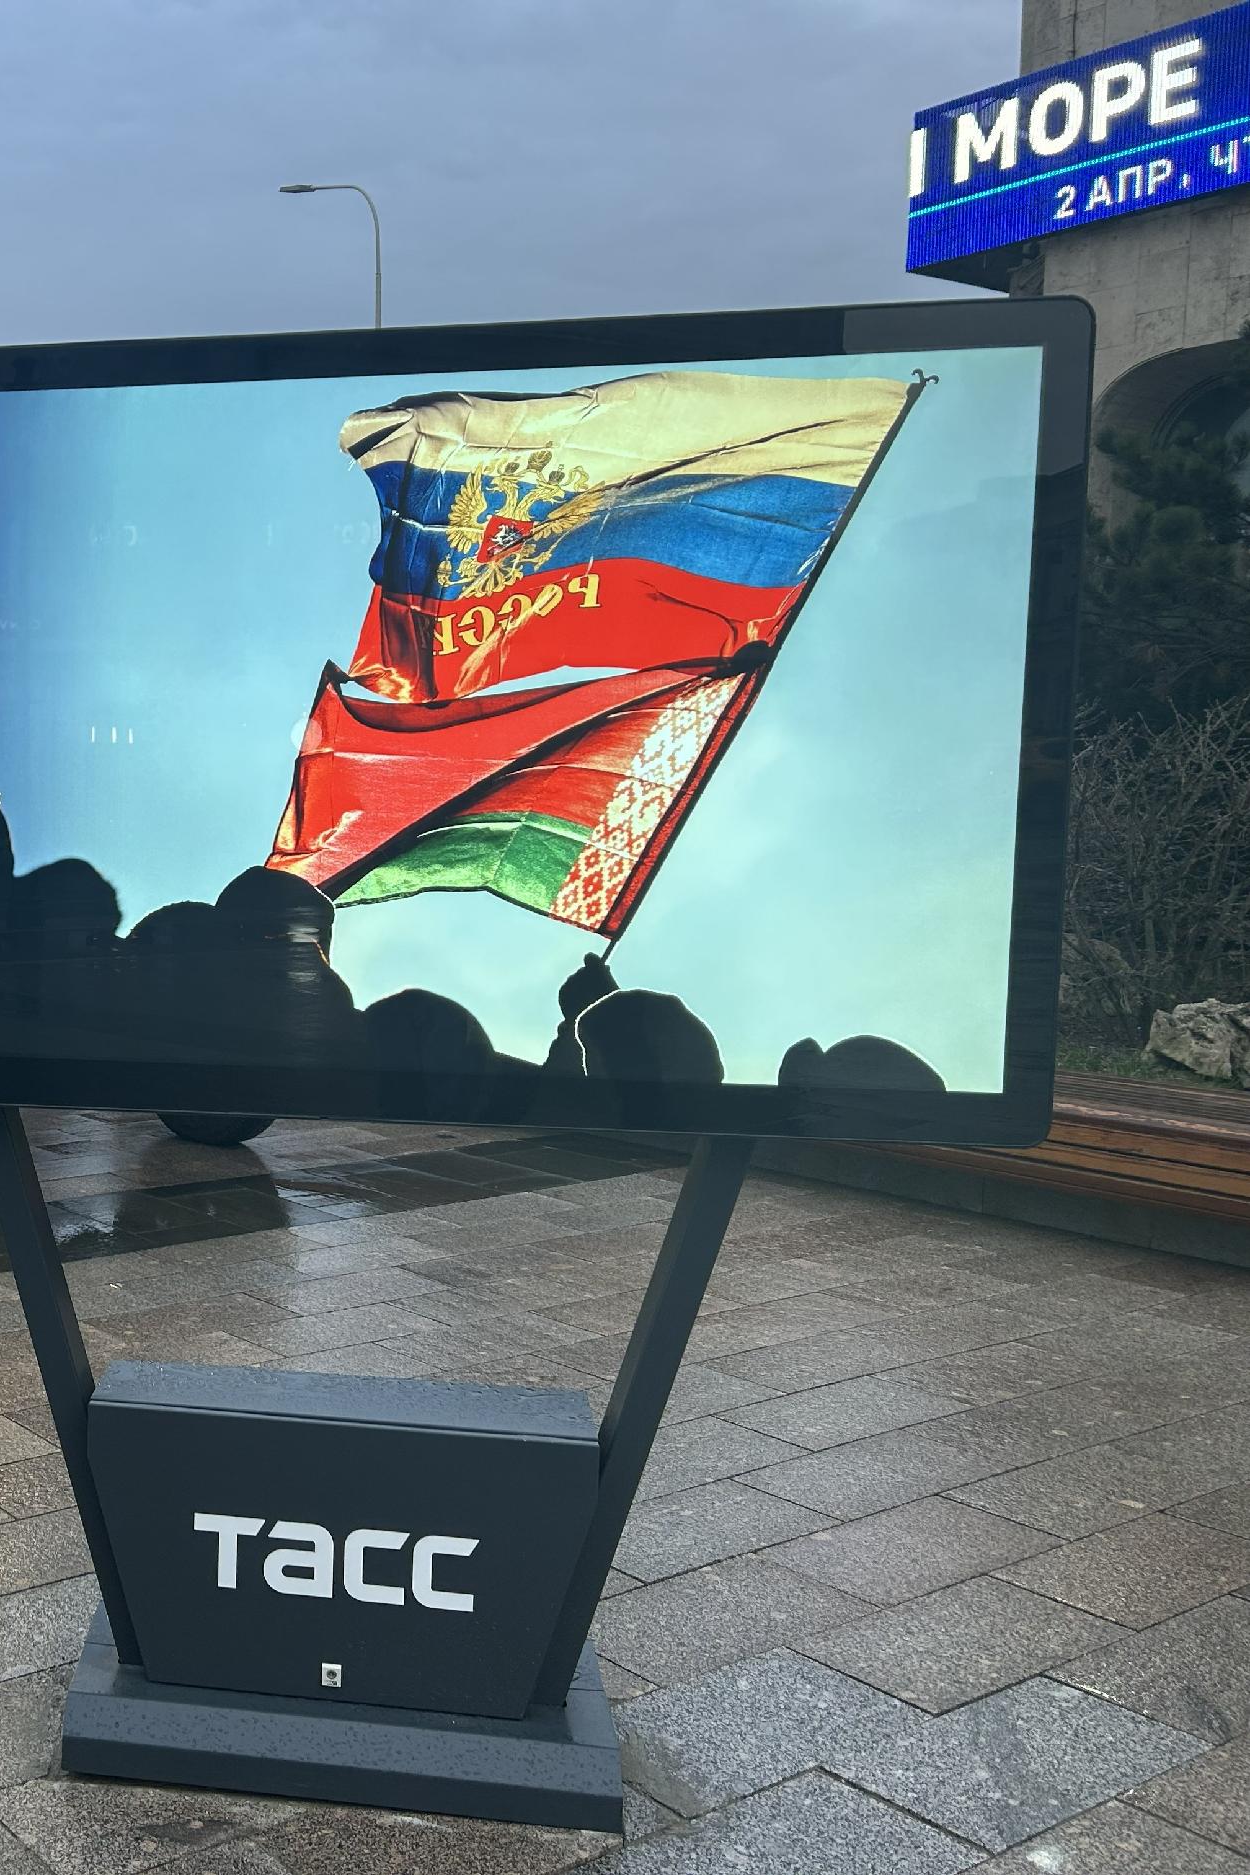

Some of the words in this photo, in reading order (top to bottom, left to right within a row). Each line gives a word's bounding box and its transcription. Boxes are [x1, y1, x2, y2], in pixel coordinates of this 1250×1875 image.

[953, 36, 1203, 184] МОРЕ
[1053, 184, 1077, 220] 2
[1209, 135, 1250, 175] Ч
